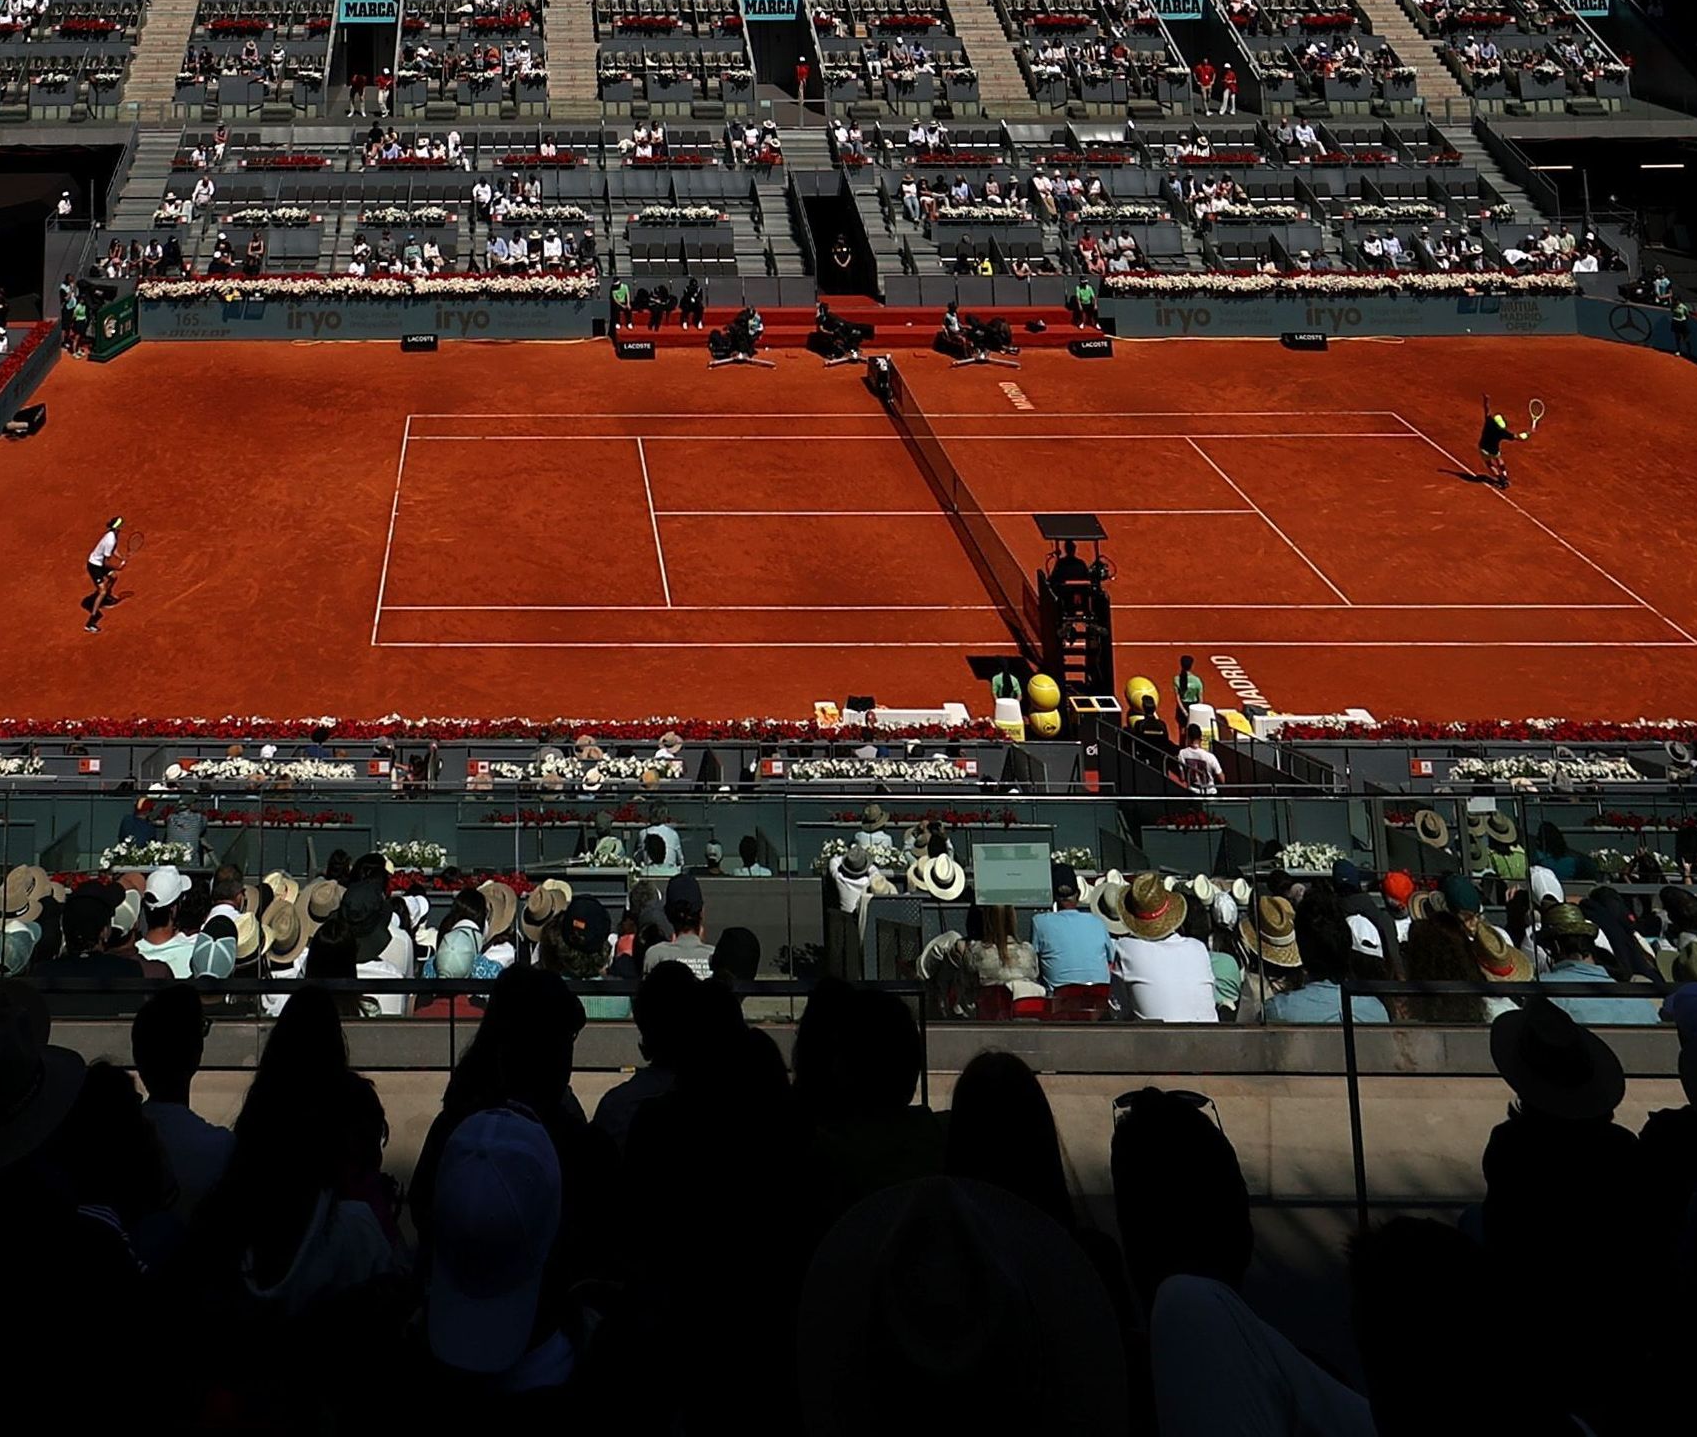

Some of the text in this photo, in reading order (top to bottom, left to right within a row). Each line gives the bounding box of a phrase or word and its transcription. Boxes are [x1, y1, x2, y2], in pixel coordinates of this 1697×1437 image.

[345, 2, 396, 17] MARCA
[744, 0, 795, 14] MARCA
[175, 314, 199, 326] 165
[287, 305, 342, 336] iryo
[435, 304, 490, 337] iryo
[1155, 300, 1212, 333] iryo
[1305, 297, 1362, 332] iryo
[623, 342, 652, 350] LACOSTE
[1080, 340, 1109, 349] LACOSTE
[1209, 655, 1273, 709] MADRID
